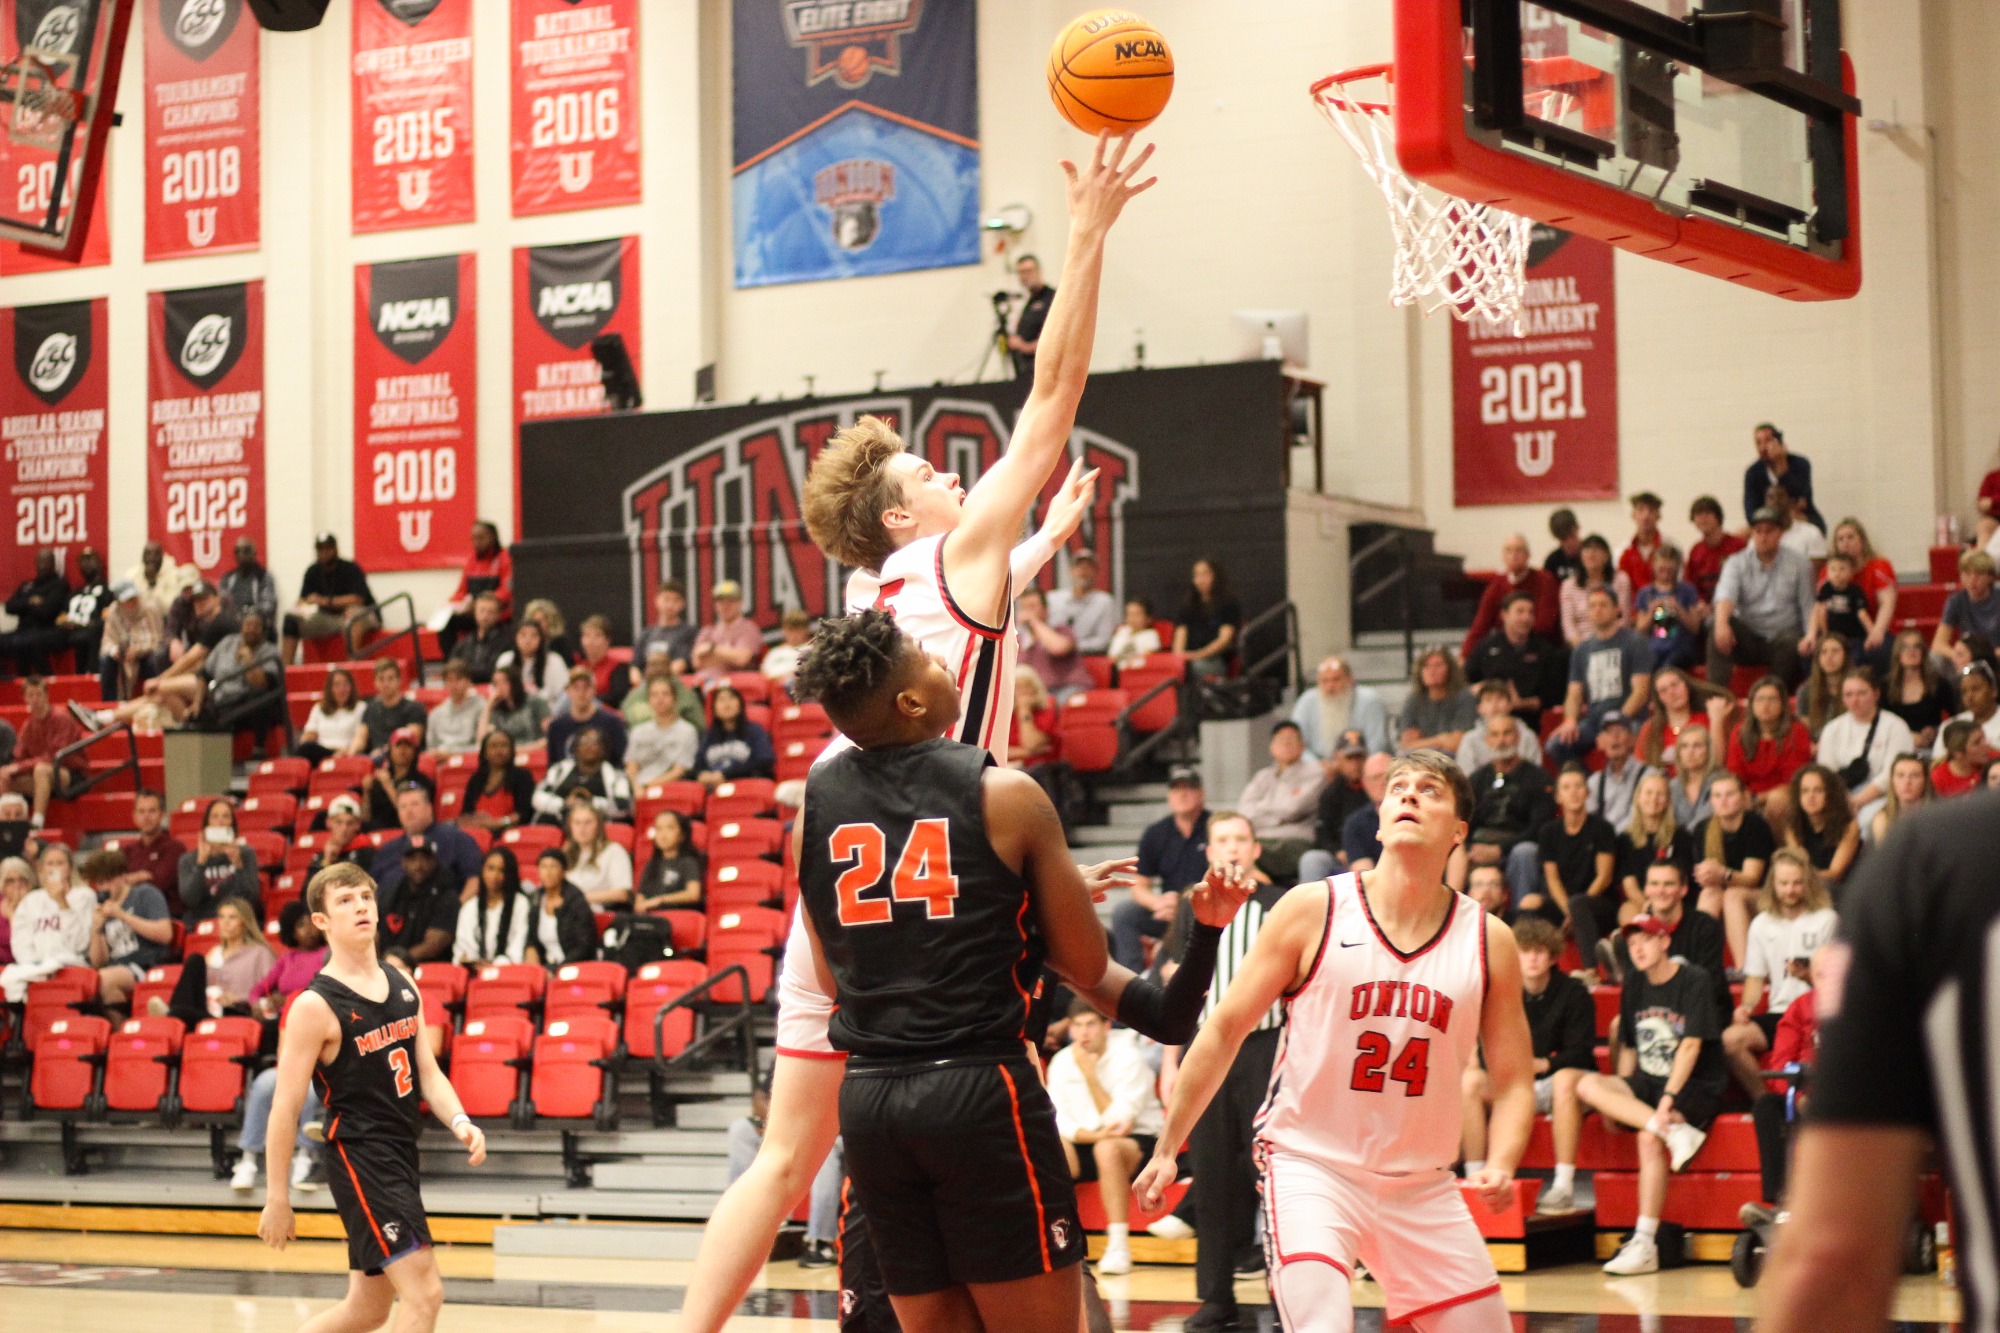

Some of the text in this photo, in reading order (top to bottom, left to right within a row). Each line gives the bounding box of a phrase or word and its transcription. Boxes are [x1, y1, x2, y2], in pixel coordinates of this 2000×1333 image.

[1115, 39, 1167, 61] NCAA
[373, 107, 454, 165] 2015
[532, 88, 619, 148] 2016
[162, 146, 241, 204] 2018
[397, 168, 432, 210] U
[558, 151, 595, 193] U
[185, 206, 218, 247] U
[378, 297, 451, 332] NCAA
[538, 280, 613, 317] NCAA
[1481, 360, 1587, 425] 2021
[373, 447, 456, 506] 2018
[1512, 429, 1556, 477] U
[17, 493, 88, 546] 2021
[167, 477, 248, 533] 2022
[397, 509, 432, 552] U
[190, 530, 222, 570] U
[828, 817, 959, 927] 24
[1350, 980, 1454, 1034] UNION
[388, 1047, 413, 1098] 2
[1350, 1030, 1430, 1097] 24
